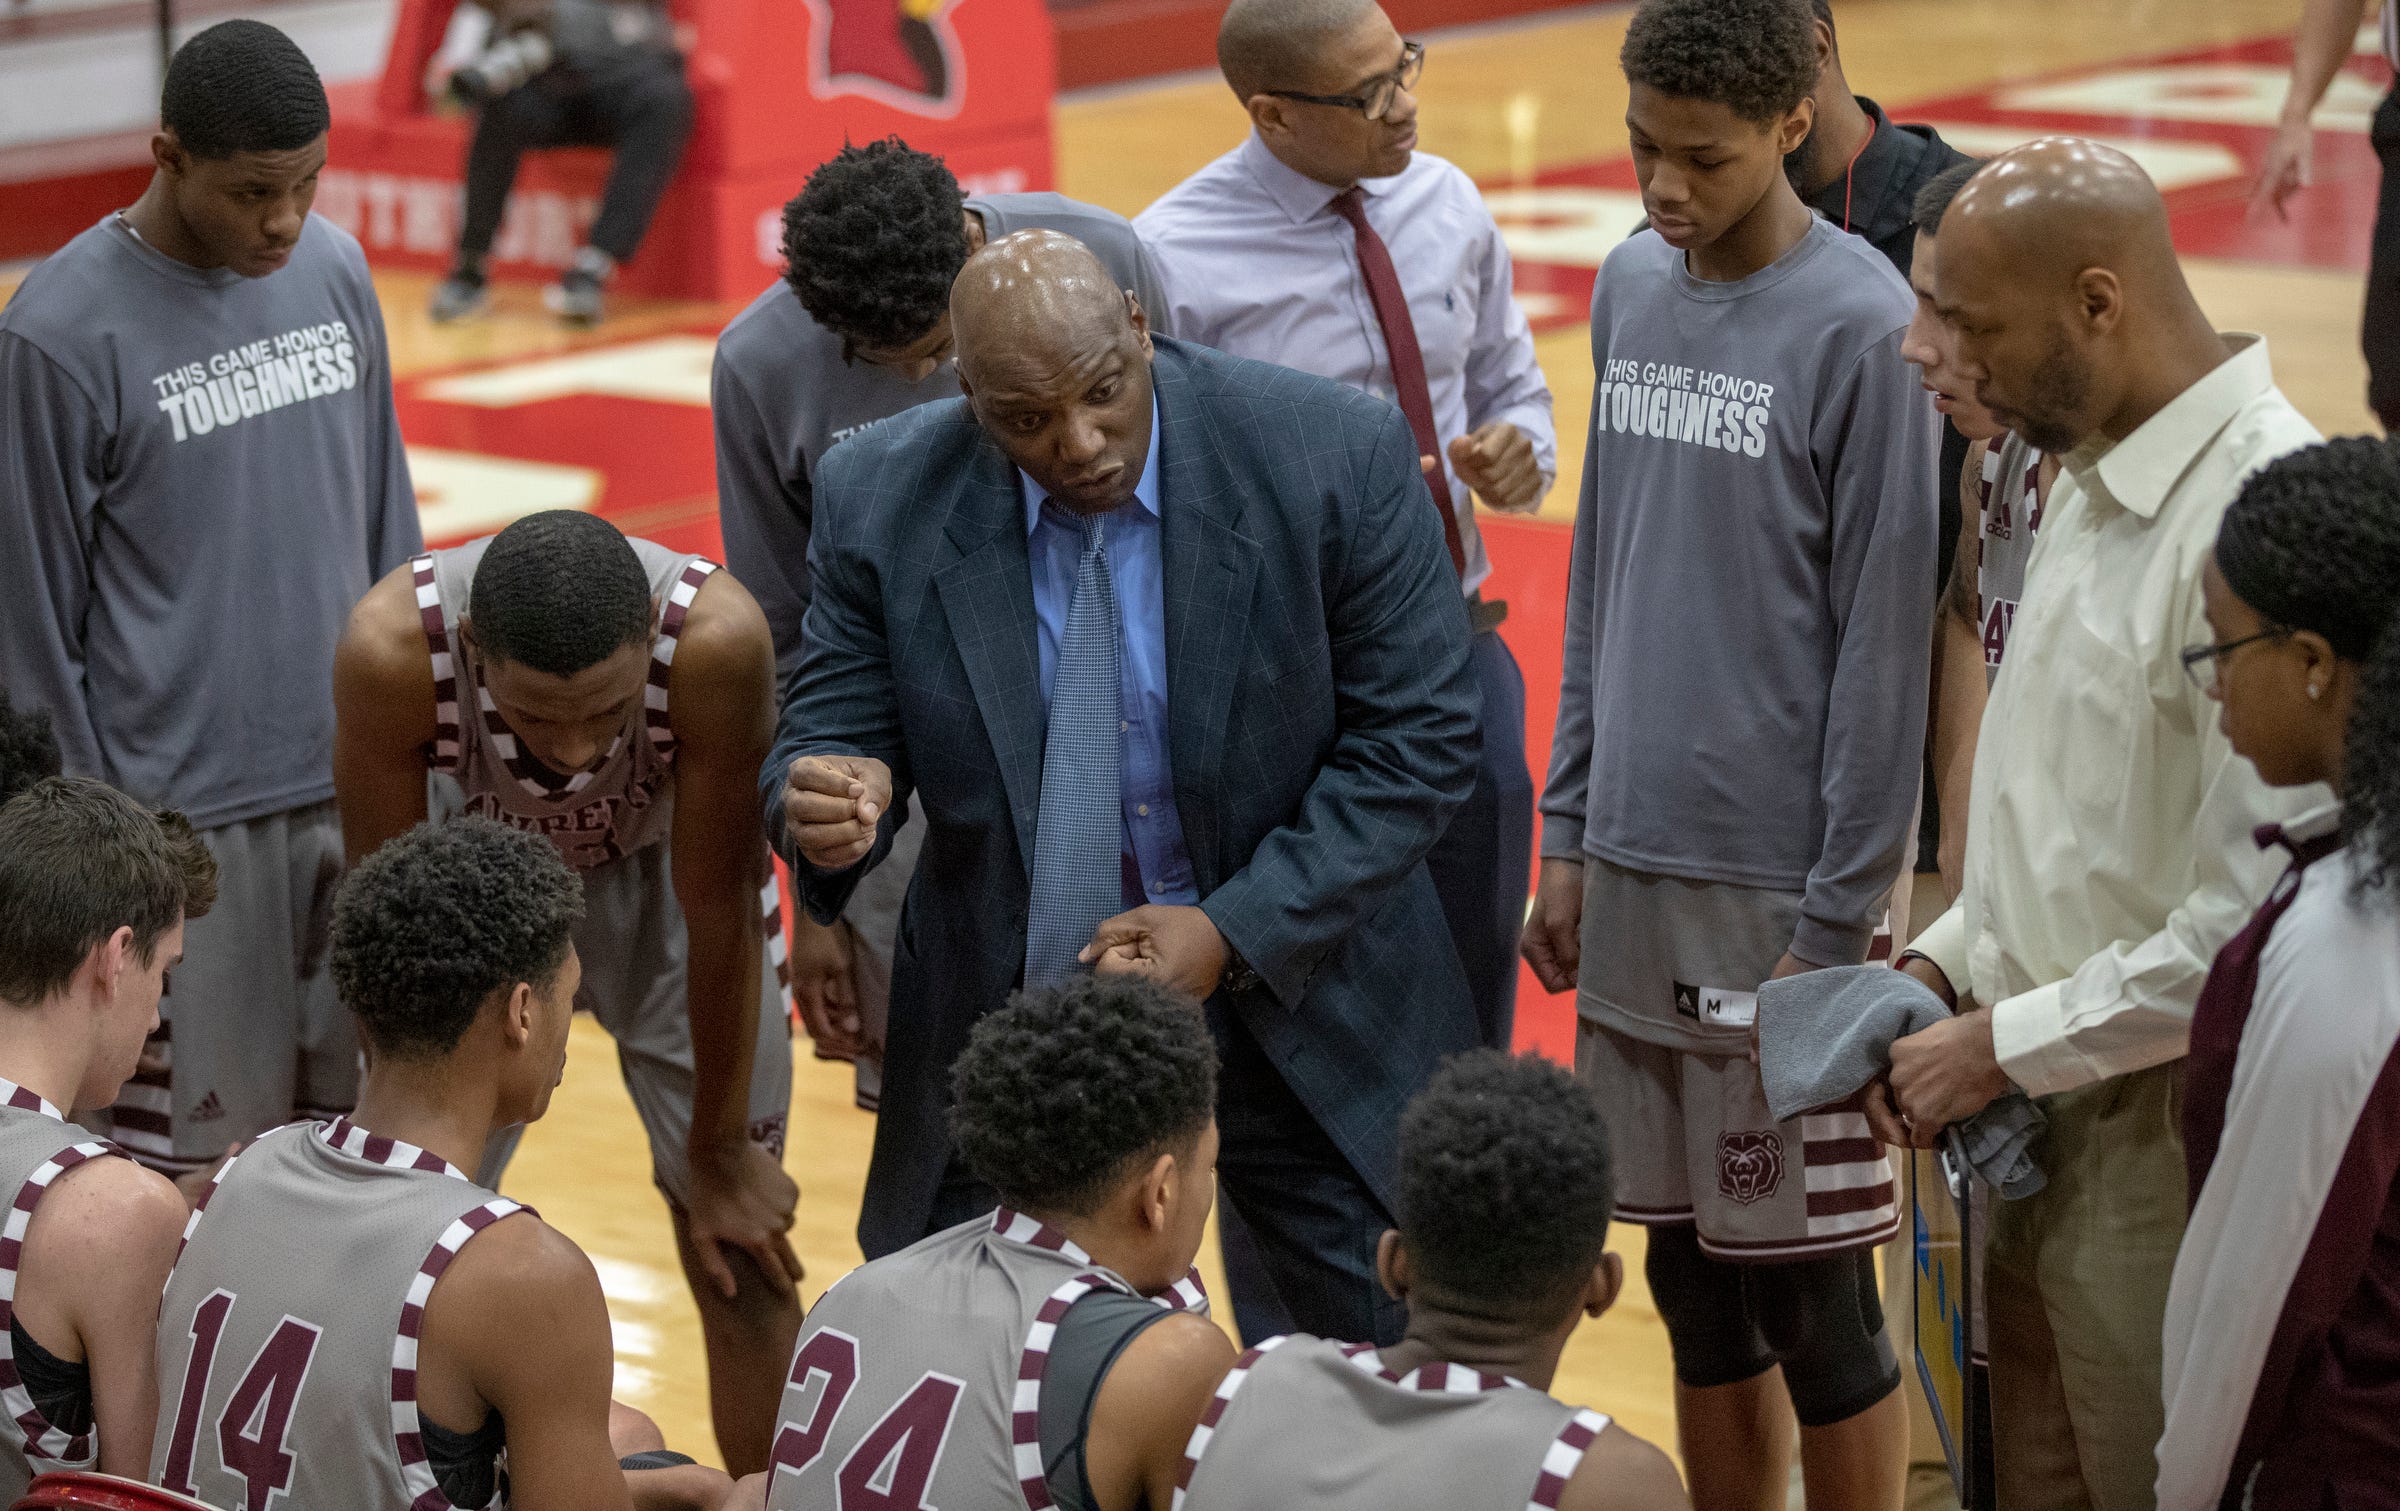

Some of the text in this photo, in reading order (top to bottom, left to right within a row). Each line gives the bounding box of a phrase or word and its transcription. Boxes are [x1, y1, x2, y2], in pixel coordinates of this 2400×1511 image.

[152, 320, 352, 397] THIS GAME HONOR
[157, 342, 357, 443] TOUGHNESS
[1642, 362, 1695, 391] GAME
[1697, 369, 1775, 408] HONOR
[1599, 382, 1769, 459] TOUGHNESS
[1706, 998, 1722, 1015] M
[160, 1287, 324, 1511] 14
[765, 1325, 968, 1511] 24
